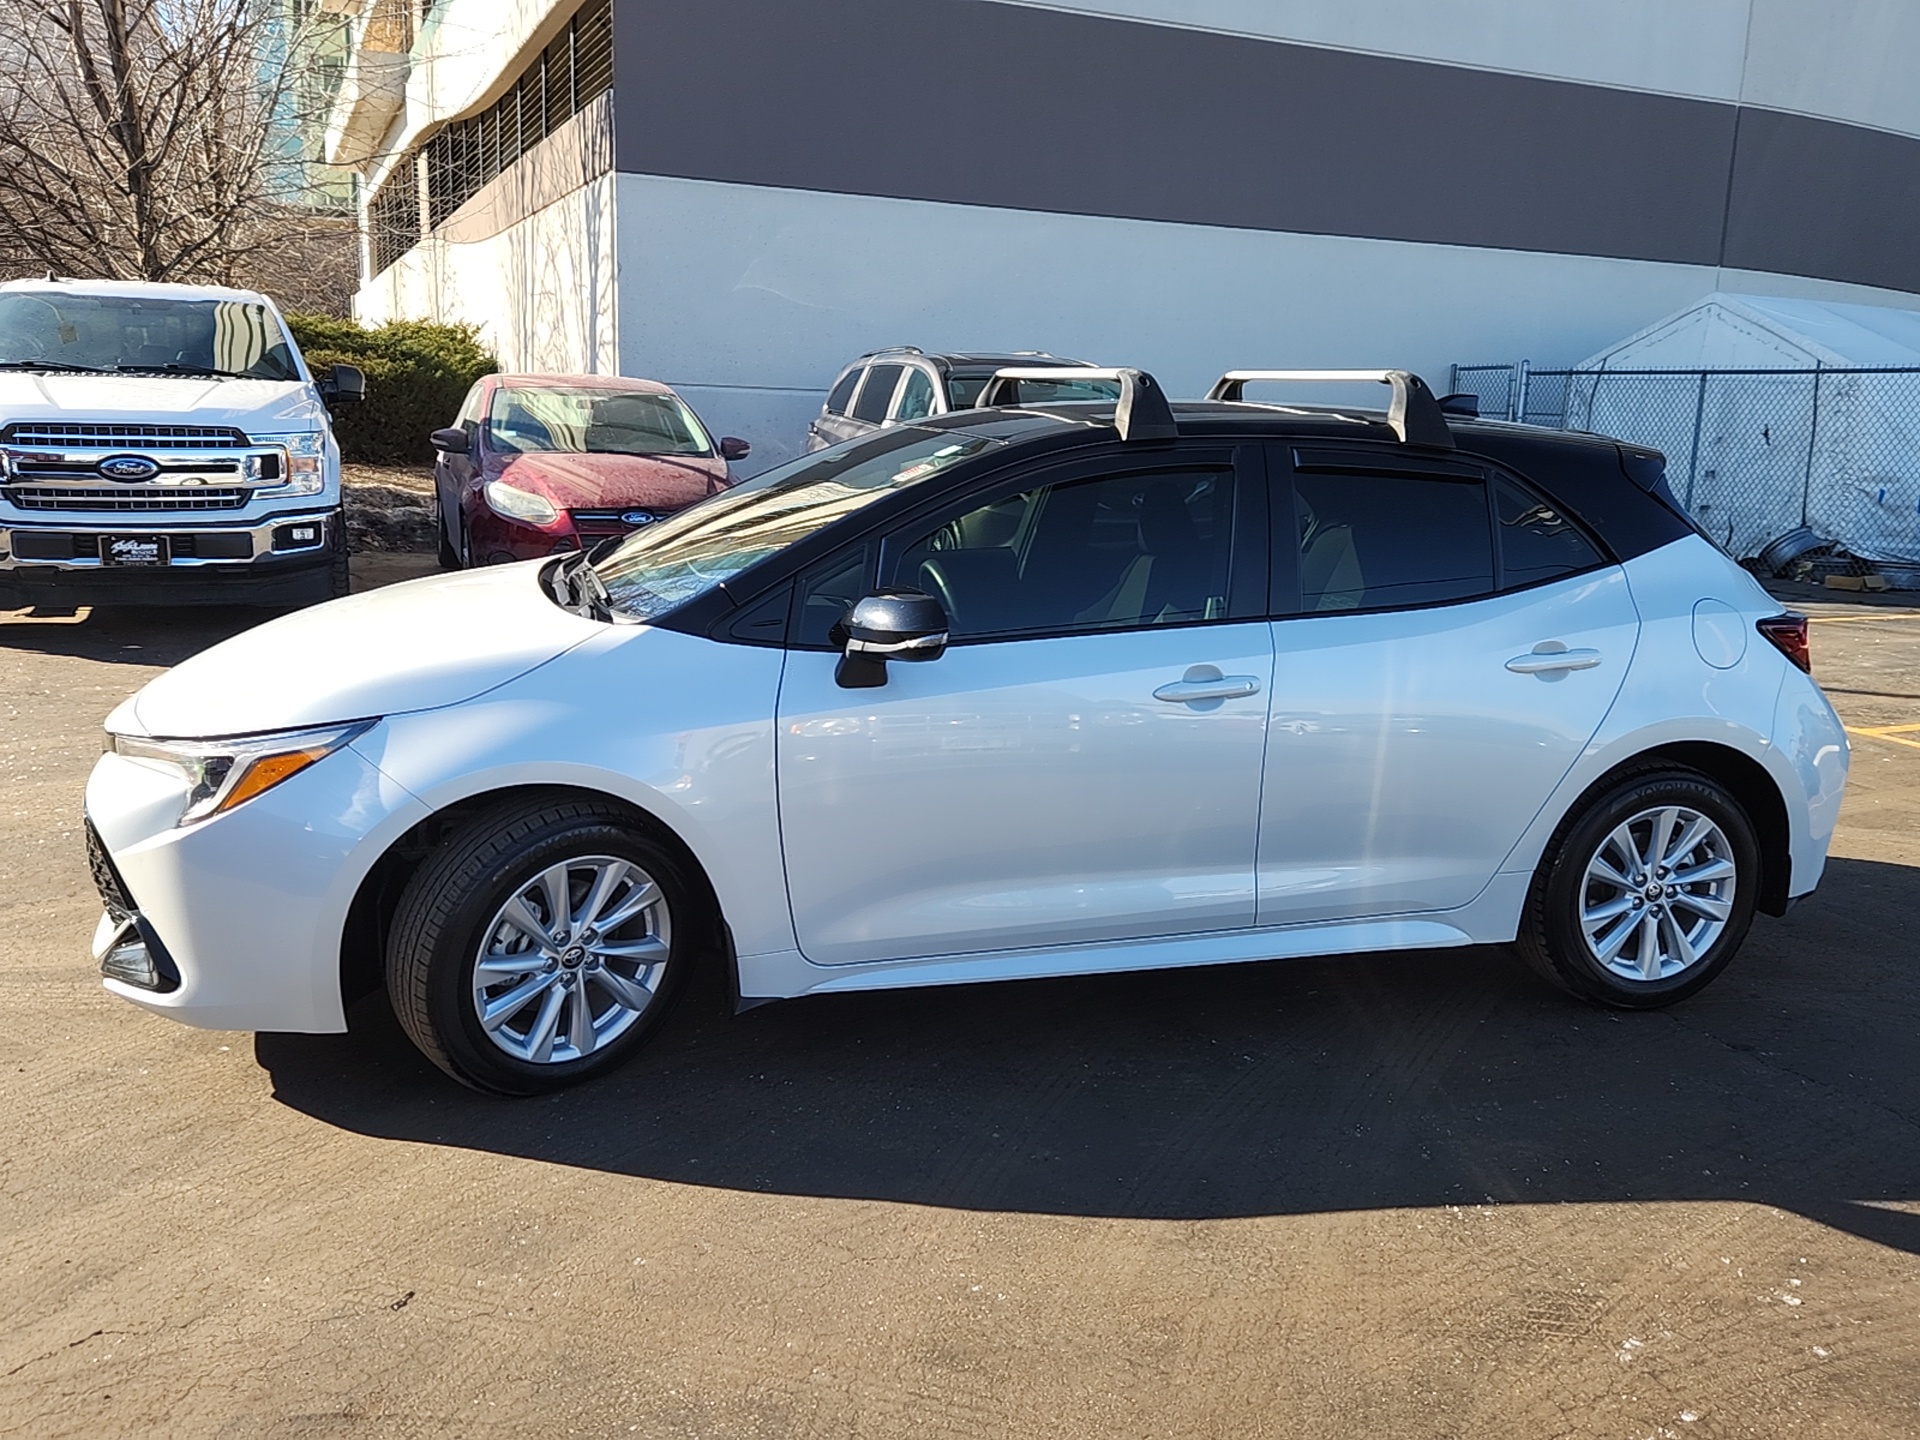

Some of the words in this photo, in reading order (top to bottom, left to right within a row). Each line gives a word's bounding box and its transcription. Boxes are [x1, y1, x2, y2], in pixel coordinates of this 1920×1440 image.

[114, 462, 145, 473] Ford
[628, 514, 647, 522] Ford
[1635, 782, 1714, 801] YOKOHAMA
